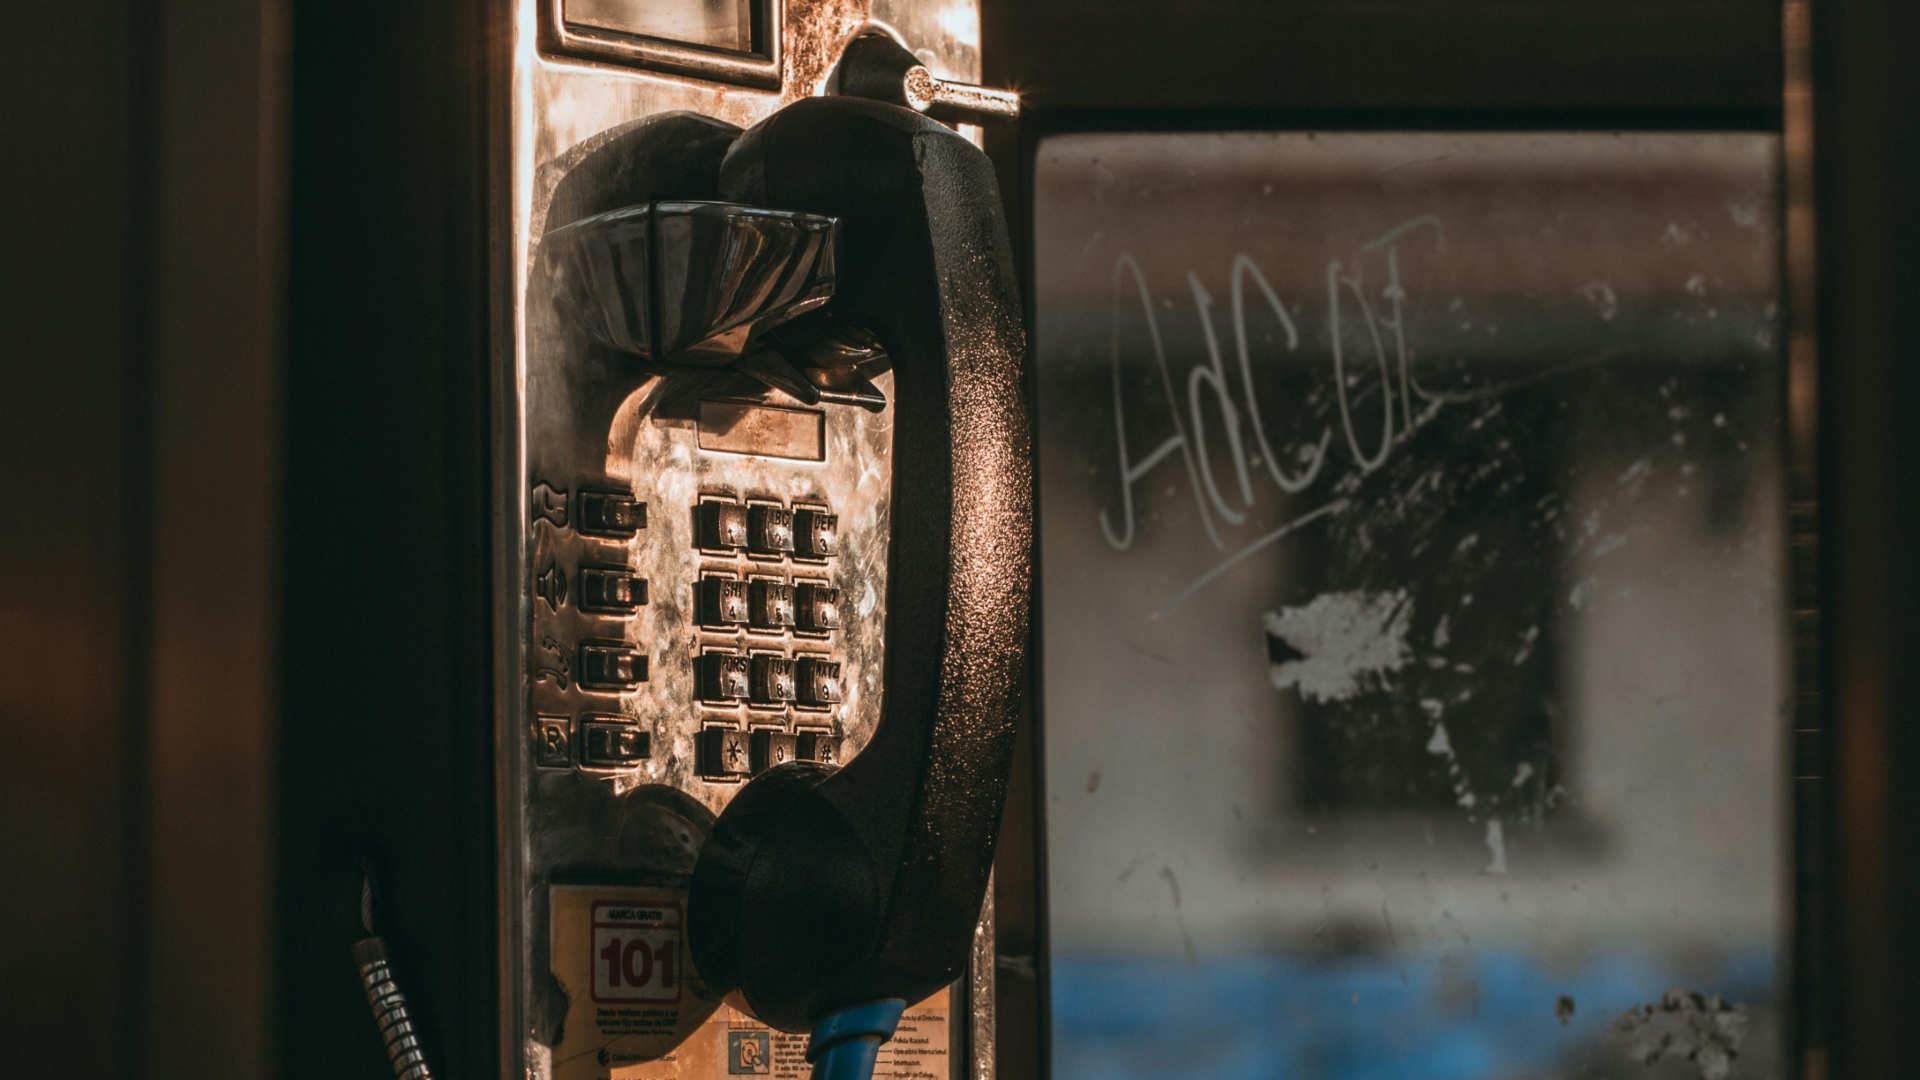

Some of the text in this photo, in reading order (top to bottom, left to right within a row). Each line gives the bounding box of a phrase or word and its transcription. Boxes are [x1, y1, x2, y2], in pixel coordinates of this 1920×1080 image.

[815, 516, 835, 531] DEF
[775, 533, 783, 546] 2
[819, 538, 827, 552] 3
[724, 582, 742, 598] GHI
[729, 604, 736, 619] 4
[775, 607, 783, 622] 5
[821, 610, 829, 626] 6
[771, 660, 791, 676] TUV
[729, 679, 736, 694] 7
[776, 683, 784, 698] 8
[822, 684, 829, 700] 9
[548, 725, 560, 755] R
[777, 746, 784, 761] 0
[609, 909, 663, 920] MARCA GRATIS
[600, 938, 674, 988] 101
